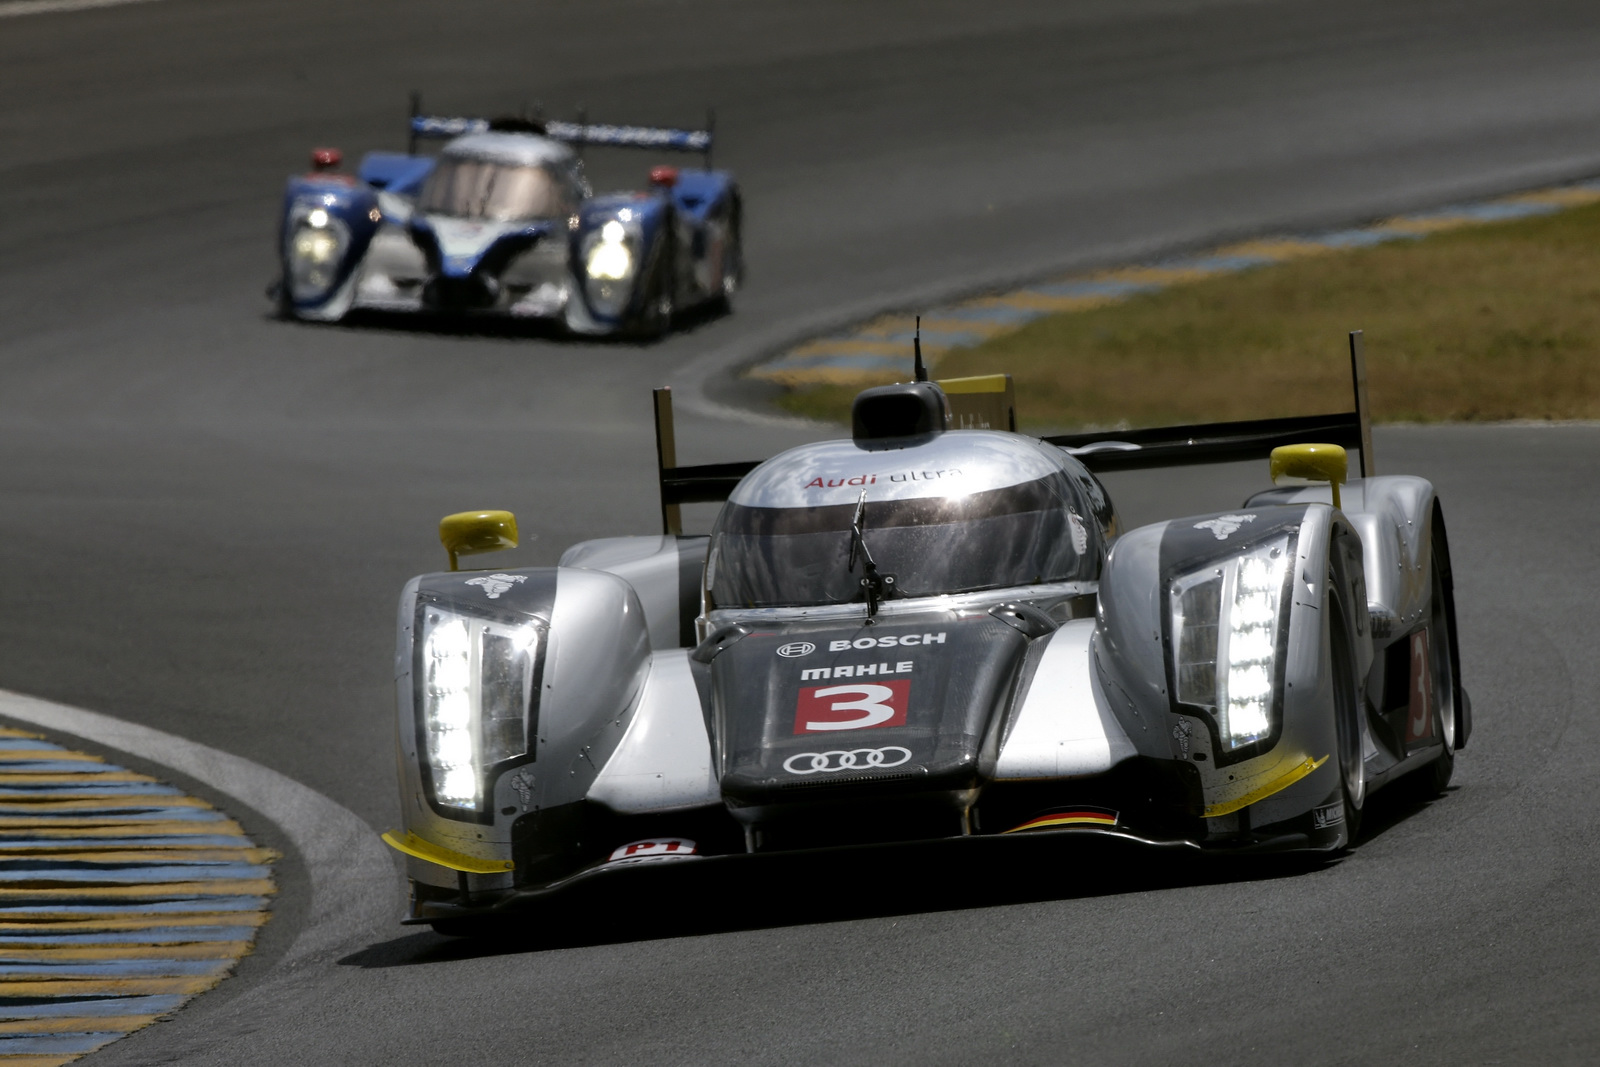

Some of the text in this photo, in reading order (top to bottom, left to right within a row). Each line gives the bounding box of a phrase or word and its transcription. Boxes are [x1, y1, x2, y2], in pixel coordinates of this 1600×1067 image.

[804, 468, 963, 489] Audi ultra
[829, 632, 946, 652] BOSCH
[801, 661, 913, 681] MAHLE
[1412, 635, 1427, 737] 3
[806, 684, 895, 731] 3
[625, 841, 682, 855] P1
